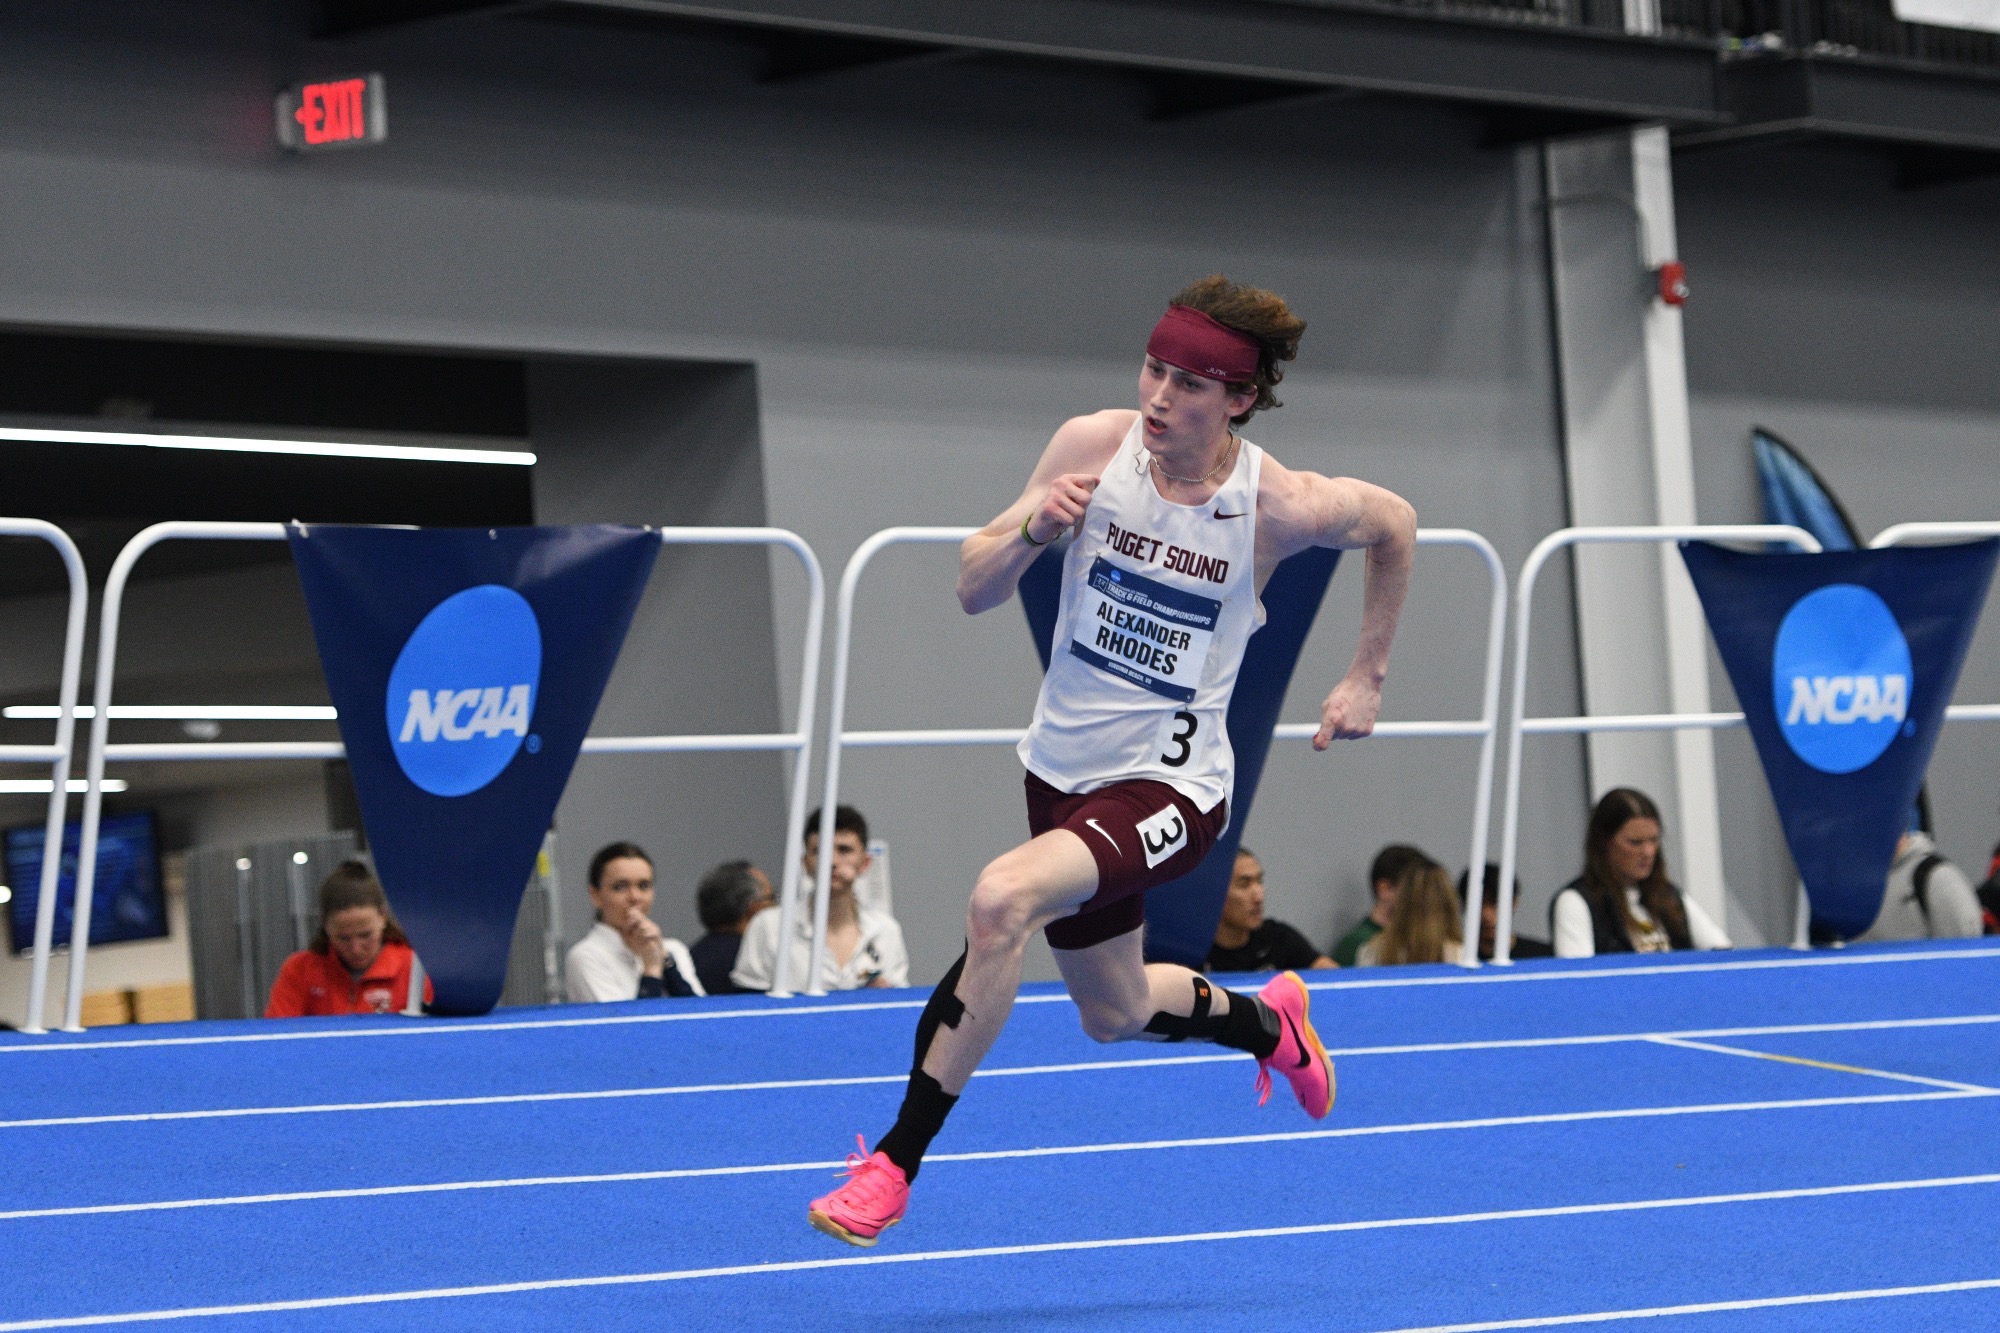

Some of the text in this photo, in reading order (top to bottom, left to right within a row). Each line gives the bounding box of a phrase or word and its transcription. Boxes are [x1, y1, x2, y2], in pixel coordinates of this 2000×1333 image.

[302, 78, 366, 145] EXIT
[1105, 521, 1229, 584] PUGET SOUND
[1096, 600, 1192, 651] ALEXANDER
[1107, 583, 1128, 599] TRACK
[1126, 593, 1134, 601] &
[1132, 594, 1153, 608] FIELD
[1152, 601, 1212, 625] CHAMPIONSHIPS
[1095, 624, 1178, 676] RHODES
[399, 684, 531, 742] NCAA
[1785, 673, 1906, 725] NCAA
[1160, 711, 1199, 768] 3
[1143, 815, 1184, 855] 3
